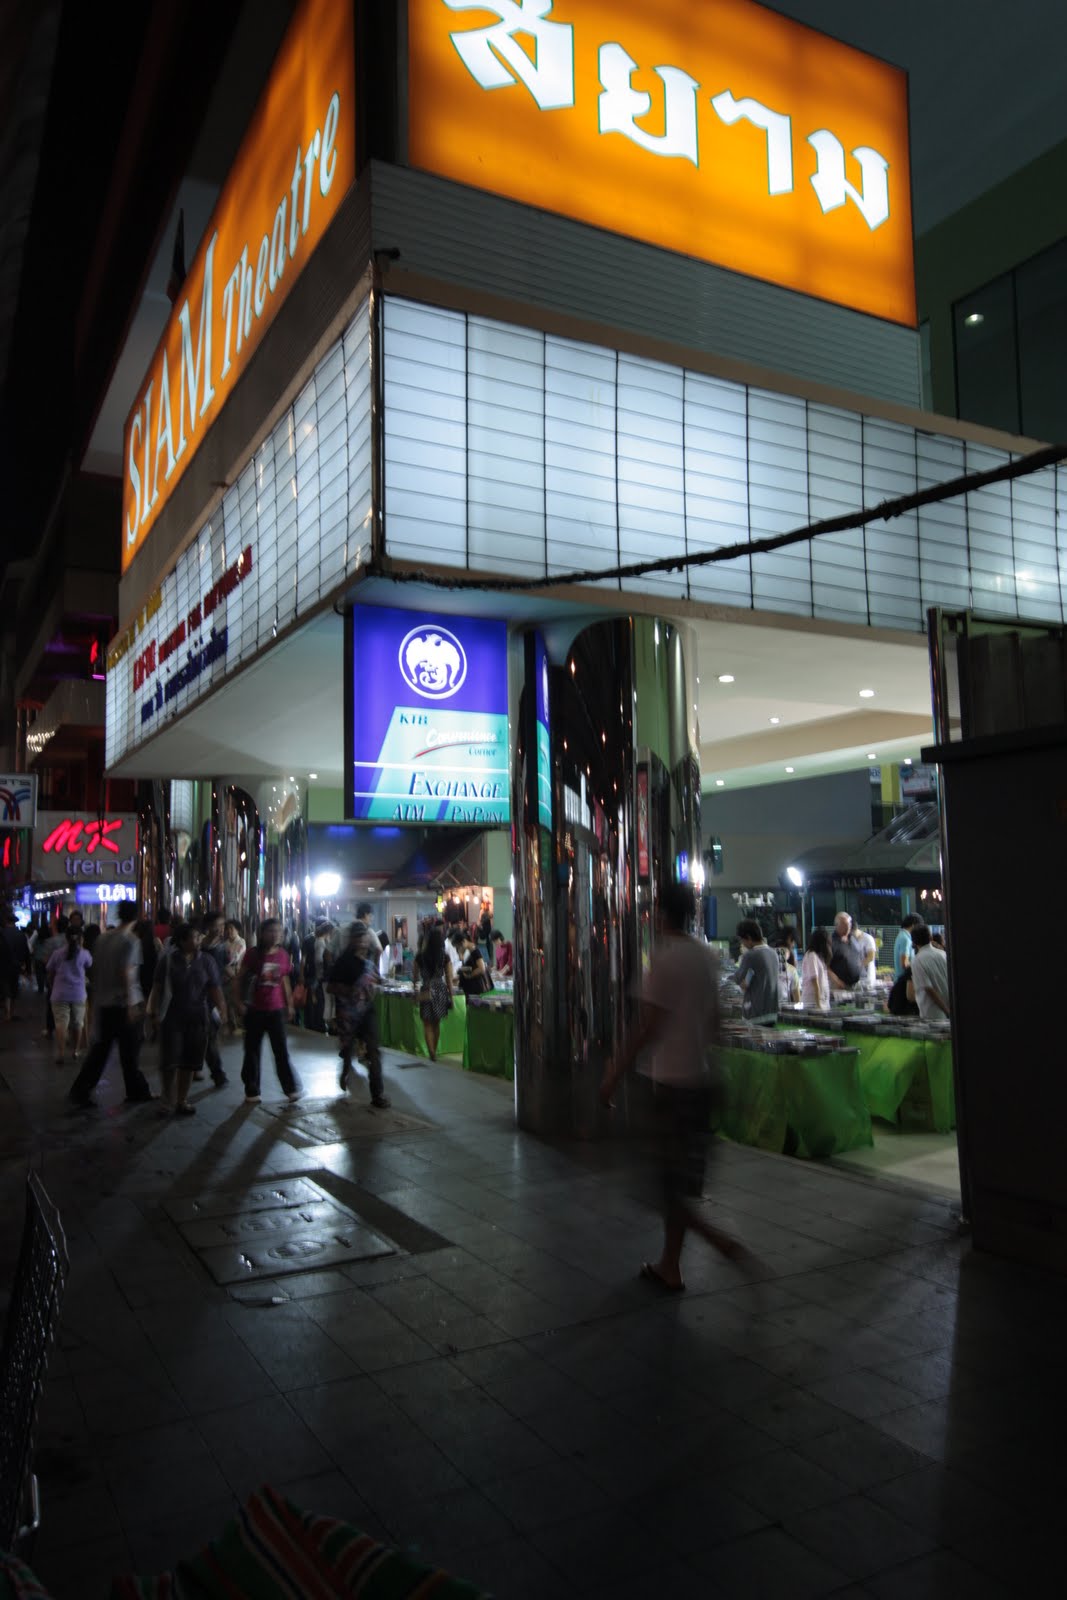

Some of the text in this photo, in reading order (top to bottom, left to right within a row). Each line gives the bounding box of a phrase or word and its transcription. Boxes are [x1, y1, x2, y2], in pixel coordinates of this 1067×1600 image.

[126, 228, 219, 548] SIAM
[220, 89, 341, 382] Theatre
[400, 713, 428, 725] KTB
[392, 803, 427, 822] ATM
[42, 818, 124, 854] MK
[65, 856, 135, 877] trend
